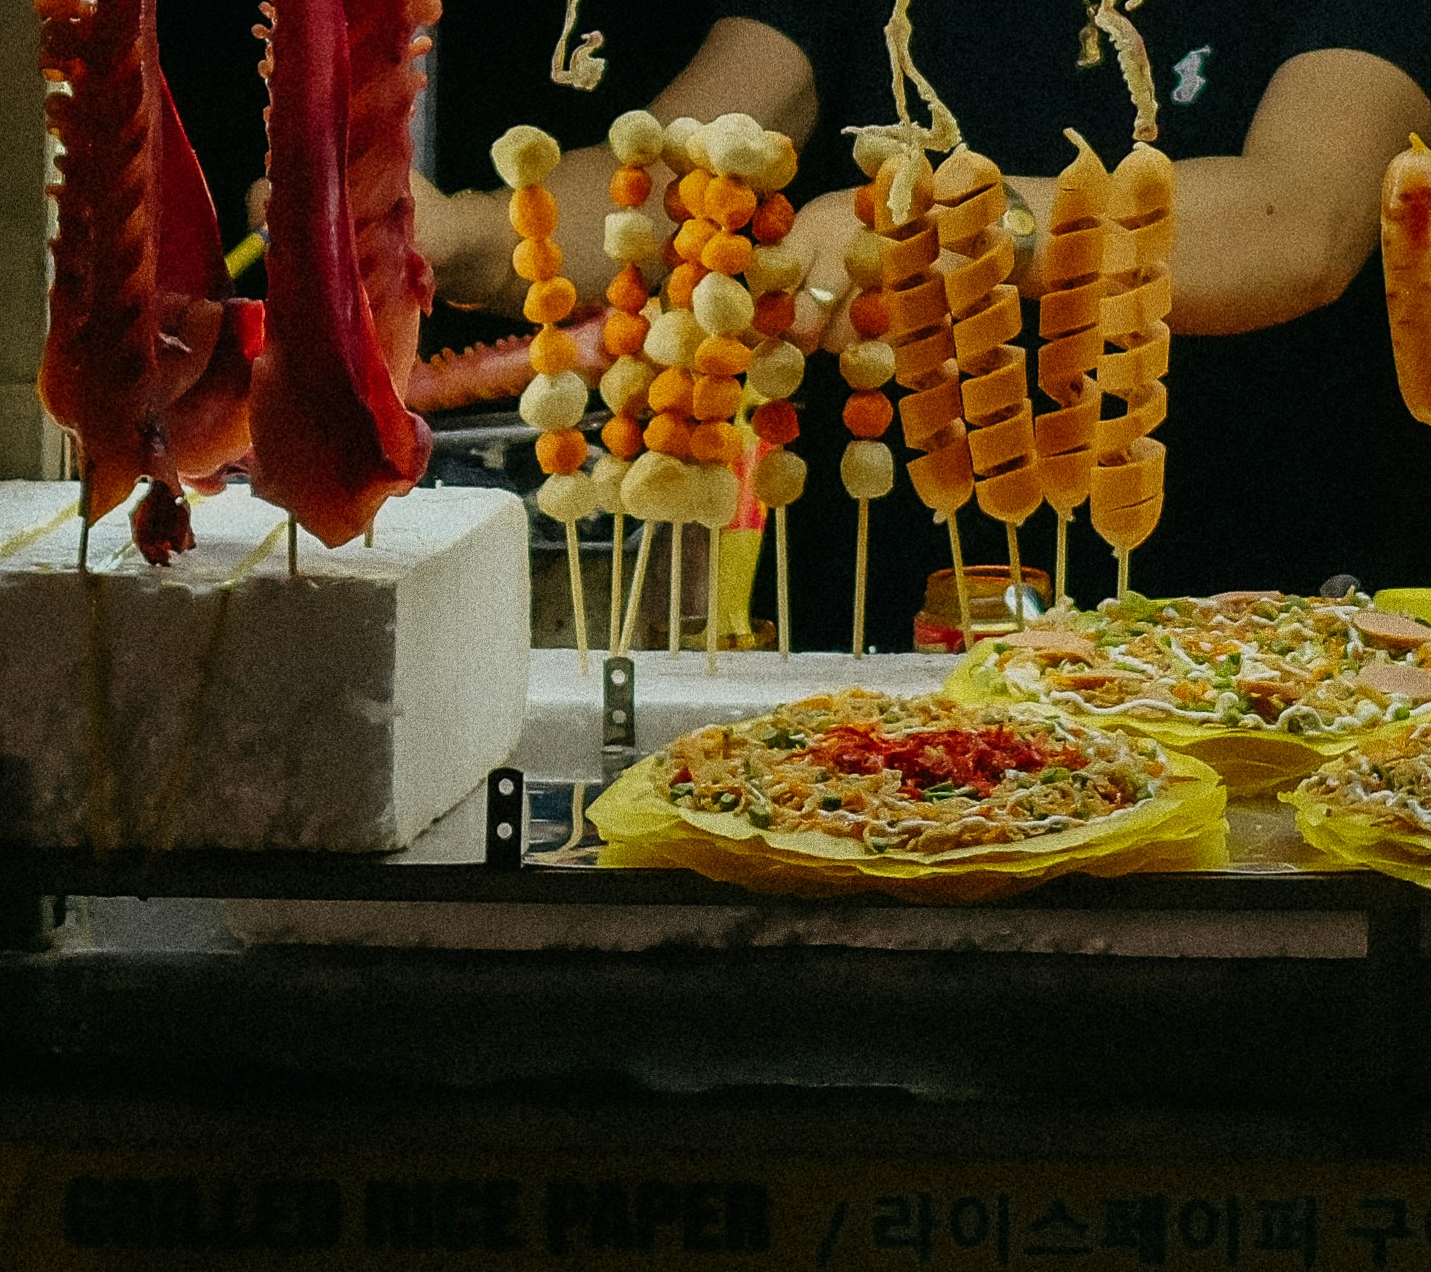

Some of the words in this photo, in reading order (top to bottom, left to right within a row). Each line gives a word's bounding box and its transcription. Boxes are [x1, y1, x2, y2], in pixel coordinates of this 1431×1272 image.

[64, 1177, 342, 1248] GRILLED
[364, 1179, 524, 1251] RICE
[546, 1180, 771, 1254] PAPER
[872, 1193, 1320, 1268] 라이스페이퍼
